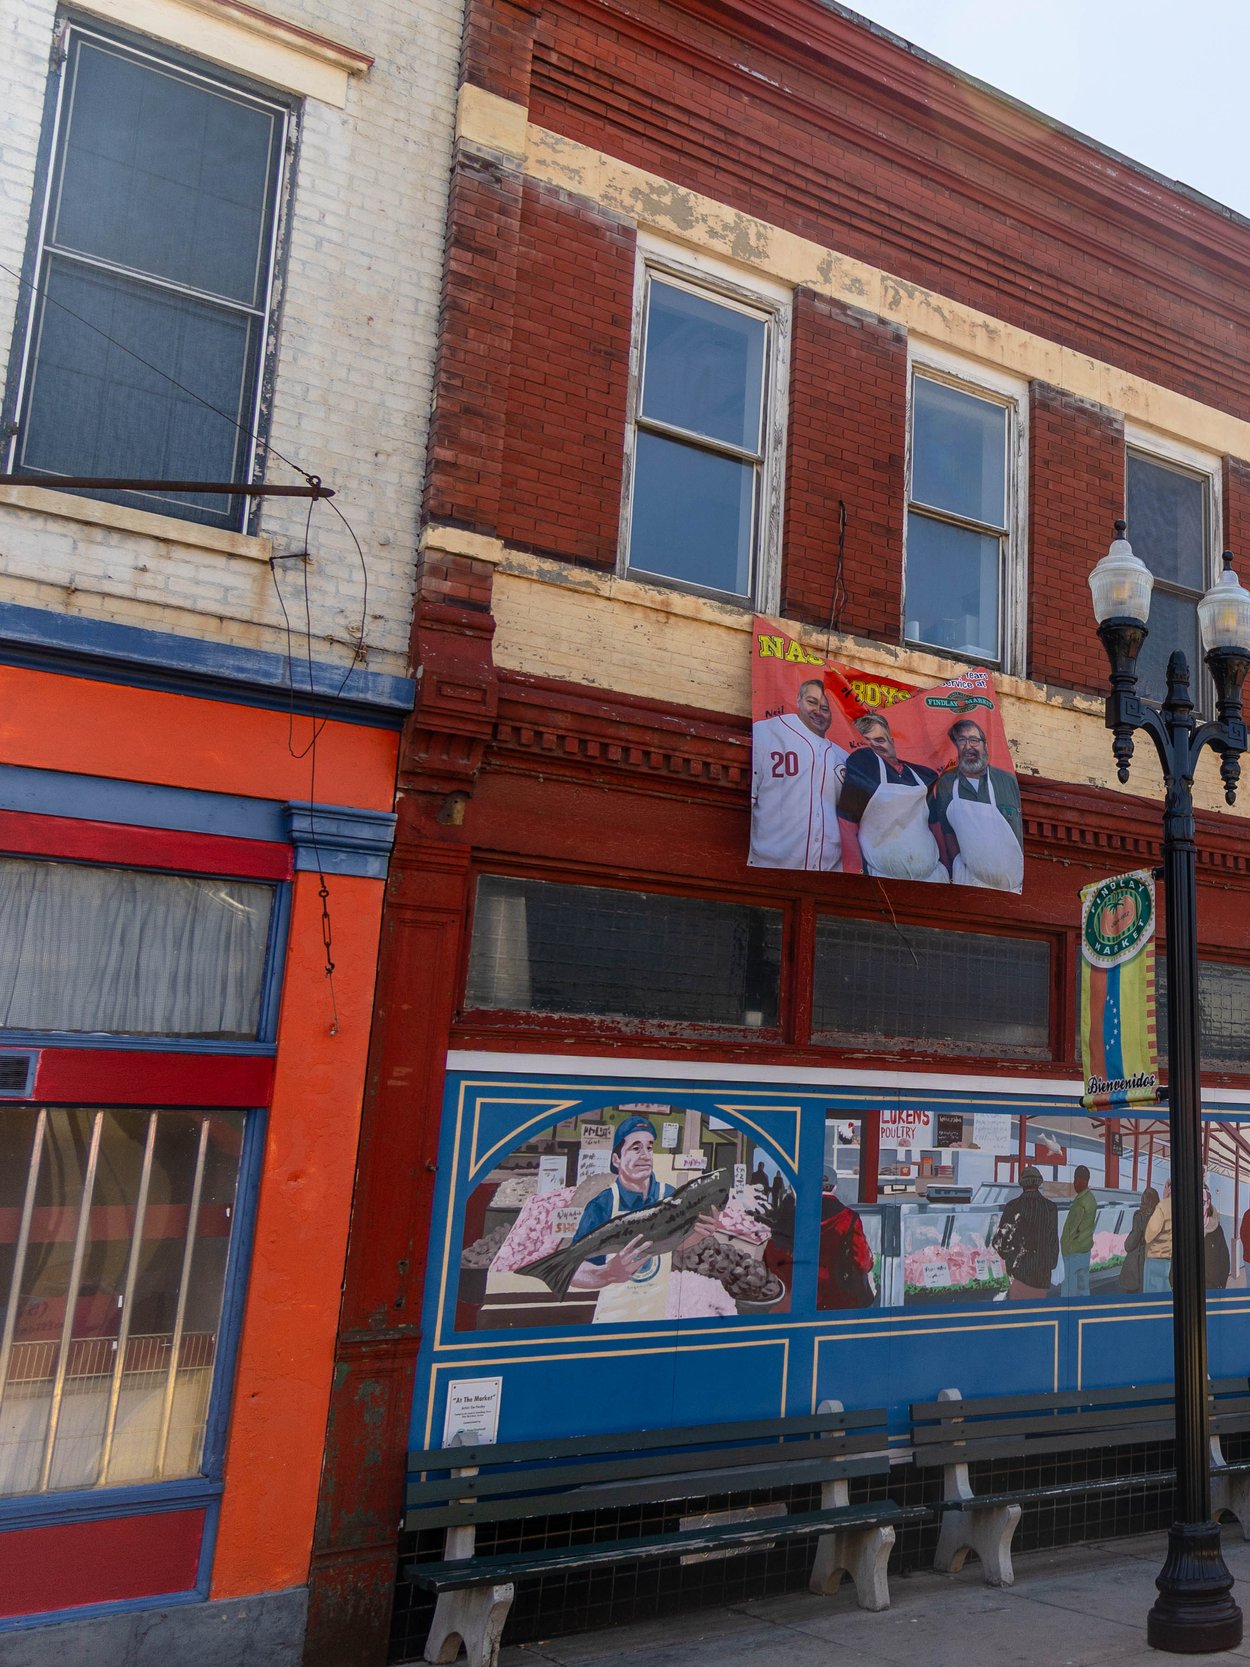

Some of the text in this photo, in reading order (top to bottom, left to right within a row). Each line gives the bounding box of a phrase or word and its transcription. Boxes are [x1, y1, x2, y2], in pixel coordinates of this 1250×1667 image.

[765, 706, 785, 718] Neil
[927, 698, 993, 708] FINDLAY MARKET
[771, 751, 799, 777] 20
[1091, 880, 1145, 914] FINDLAY
[1094, 918, 1145, 955] MARKET
[1087, 1072, 1155, 1094] Bienvenidos
[881, 1126, 917, 1140] POULTRY
